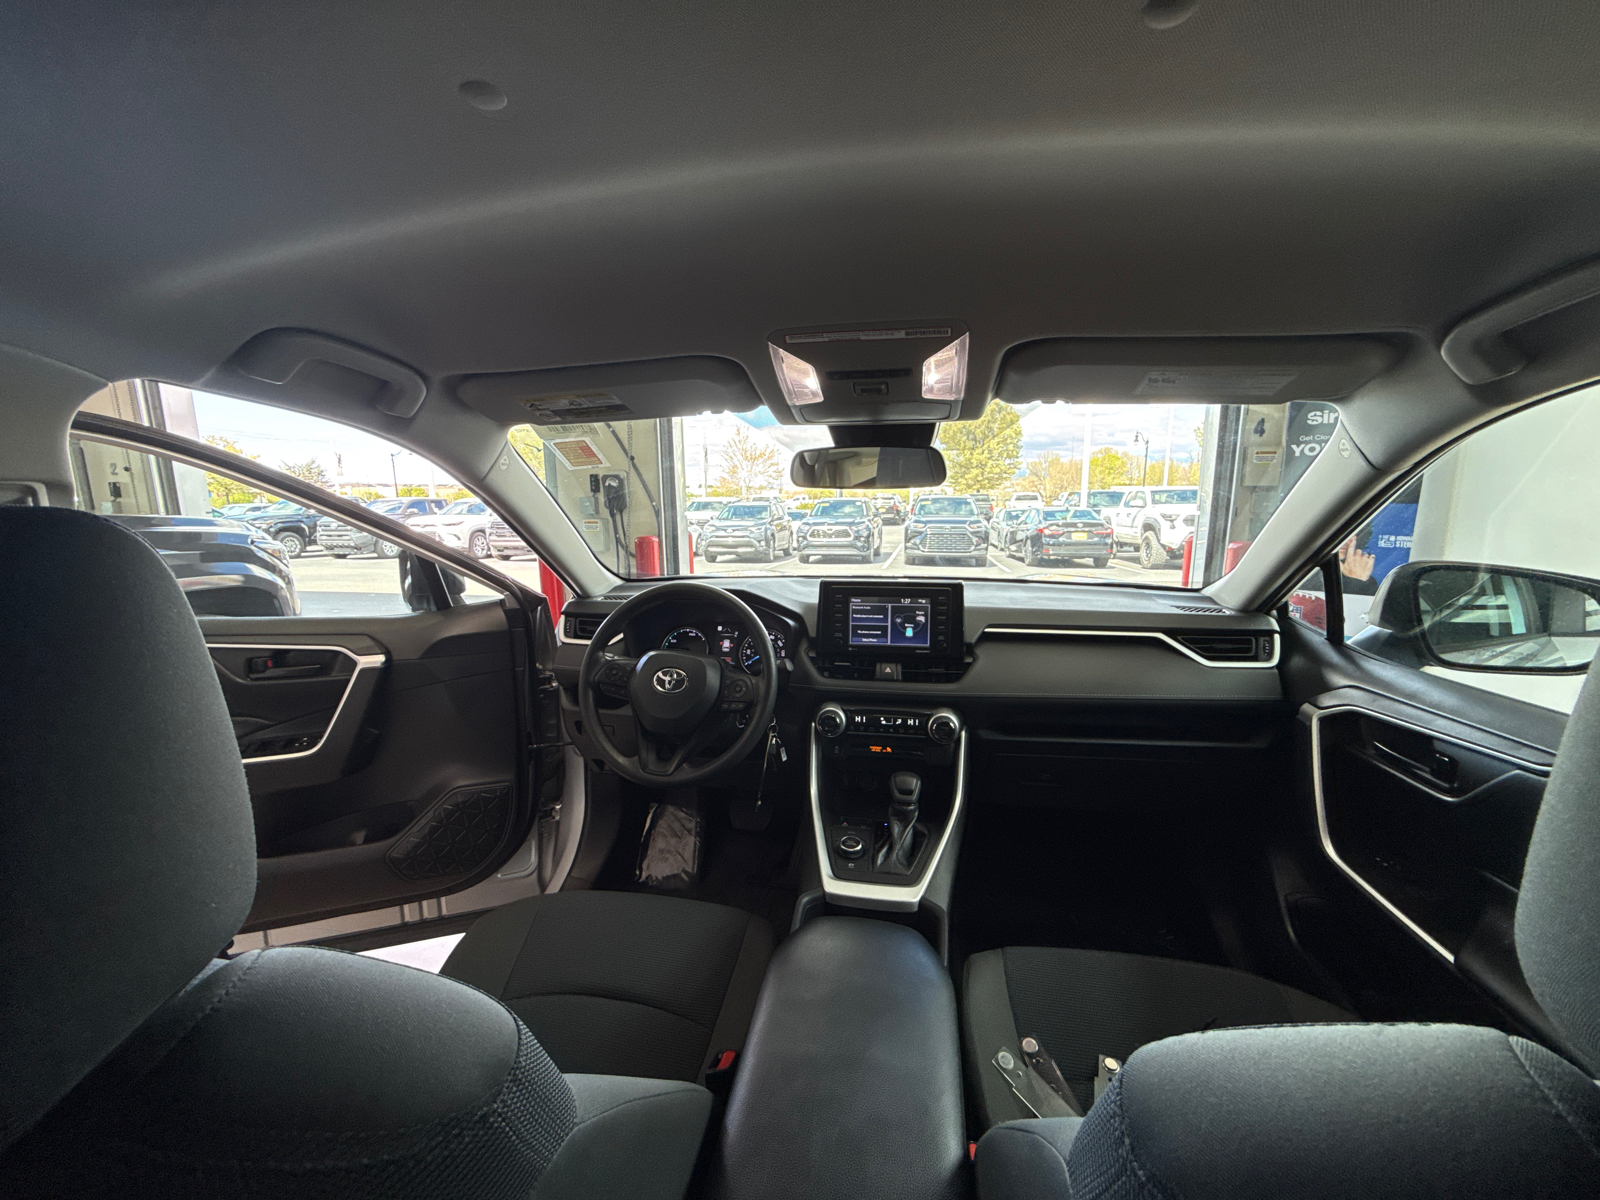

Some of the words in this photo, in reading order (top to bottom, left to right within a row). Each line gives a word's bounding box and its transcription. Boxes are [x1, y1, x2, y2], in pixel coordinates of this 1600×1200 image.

[1253, 417, 1265, 437] 4
[1290, 443, 1325, 457] YO
[110, 462, 119, 475] 2
[855, 715, 866, 723] HI
[907, 718, 919, 726] HI
